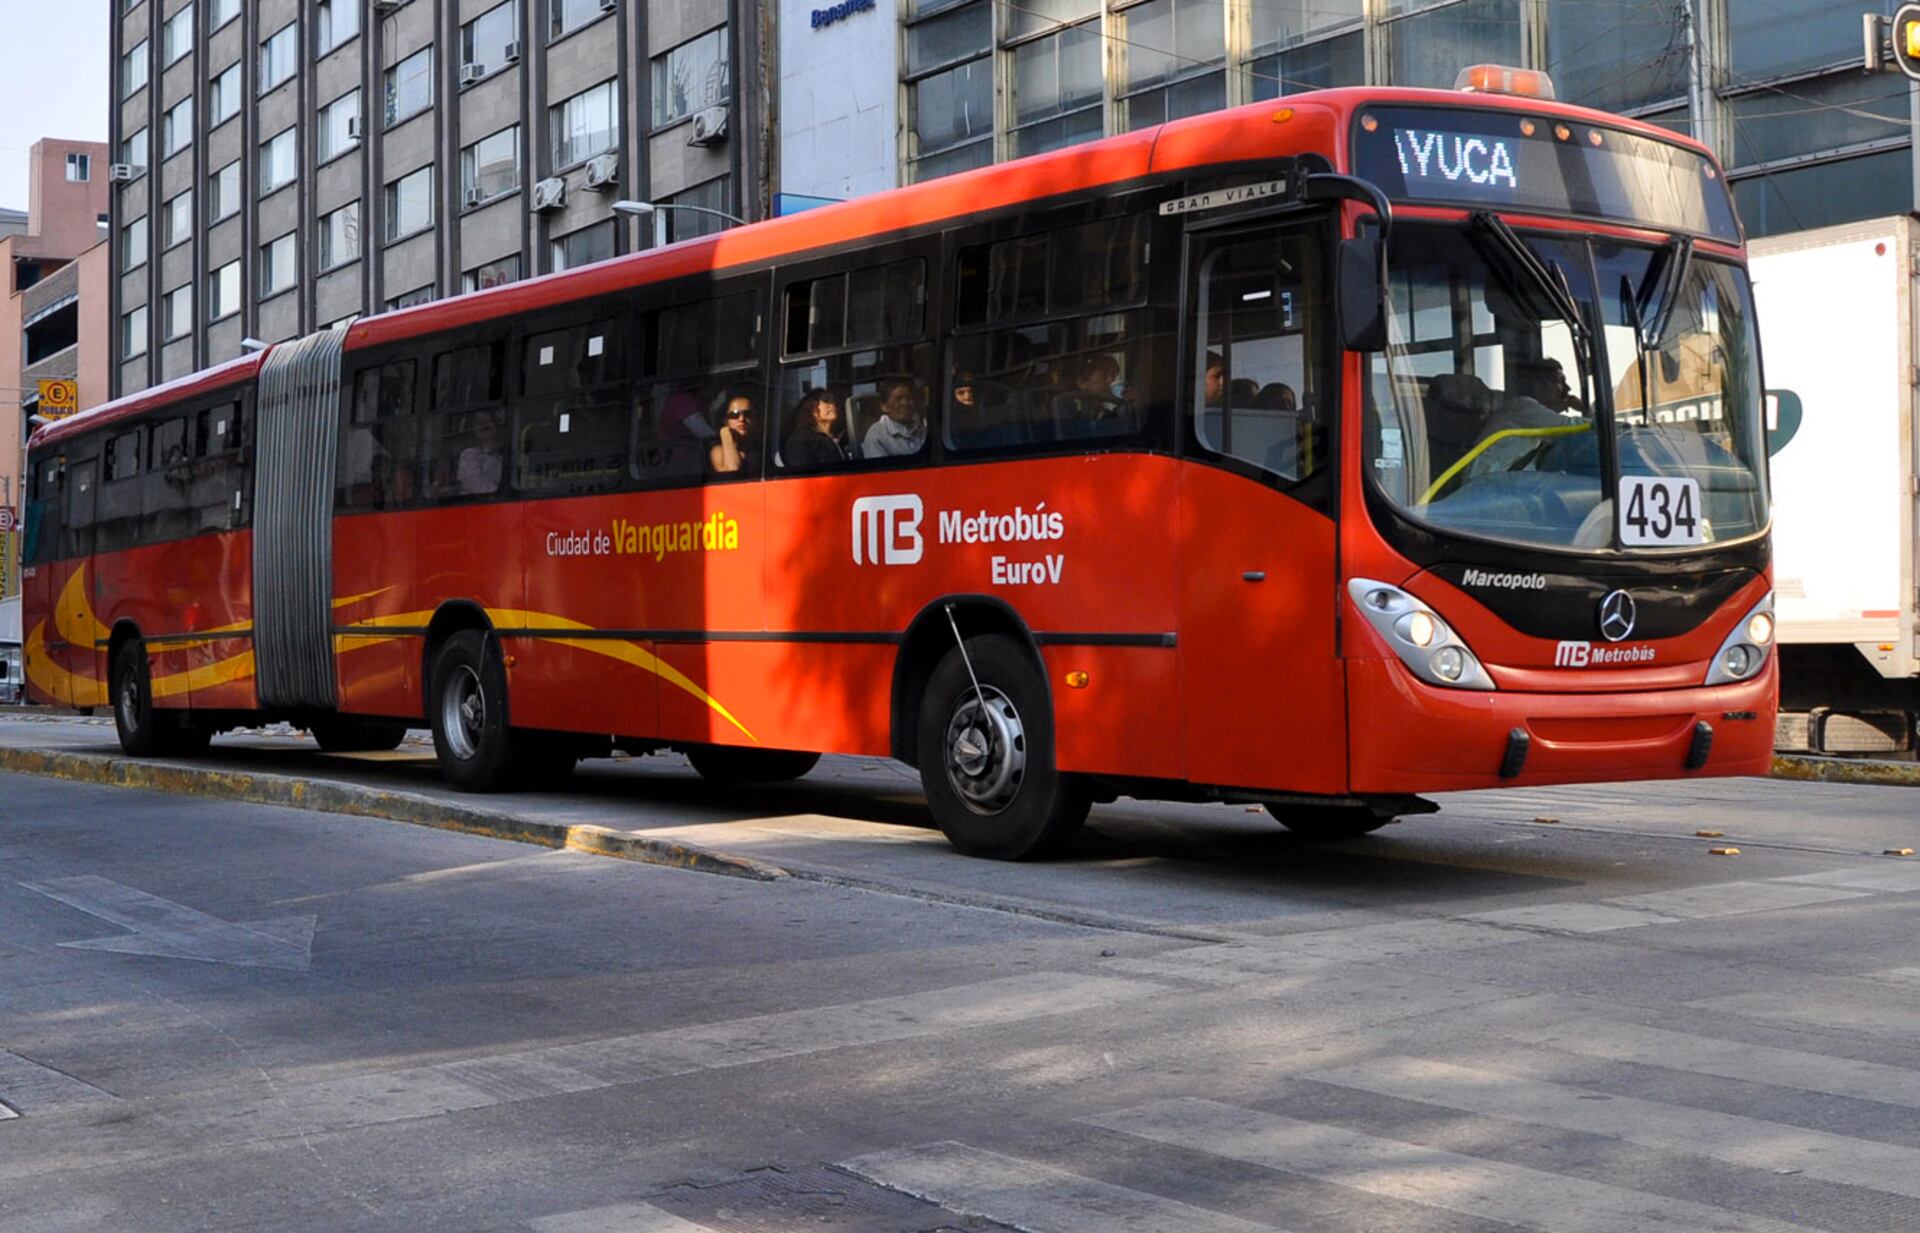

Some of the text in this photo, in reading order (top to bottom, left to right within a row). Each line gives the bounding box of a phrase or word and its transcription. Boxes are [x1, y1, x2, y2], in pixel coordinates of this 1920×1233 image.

[1167, 182, 1278, 213] GRAN VIALE
[53, 387, 63, 400] E
[938, 502, 1064, 544] Metrobús
[1626, 483, 1696, 538] 434
[546, 511, 739, 562] Ciudad de Vanguardia
[991, 554, 1064, 584] EuroV
[1462, 569, 1546, 589] Marcopolo
[1591, 645, 1655, 663] Metrobús
